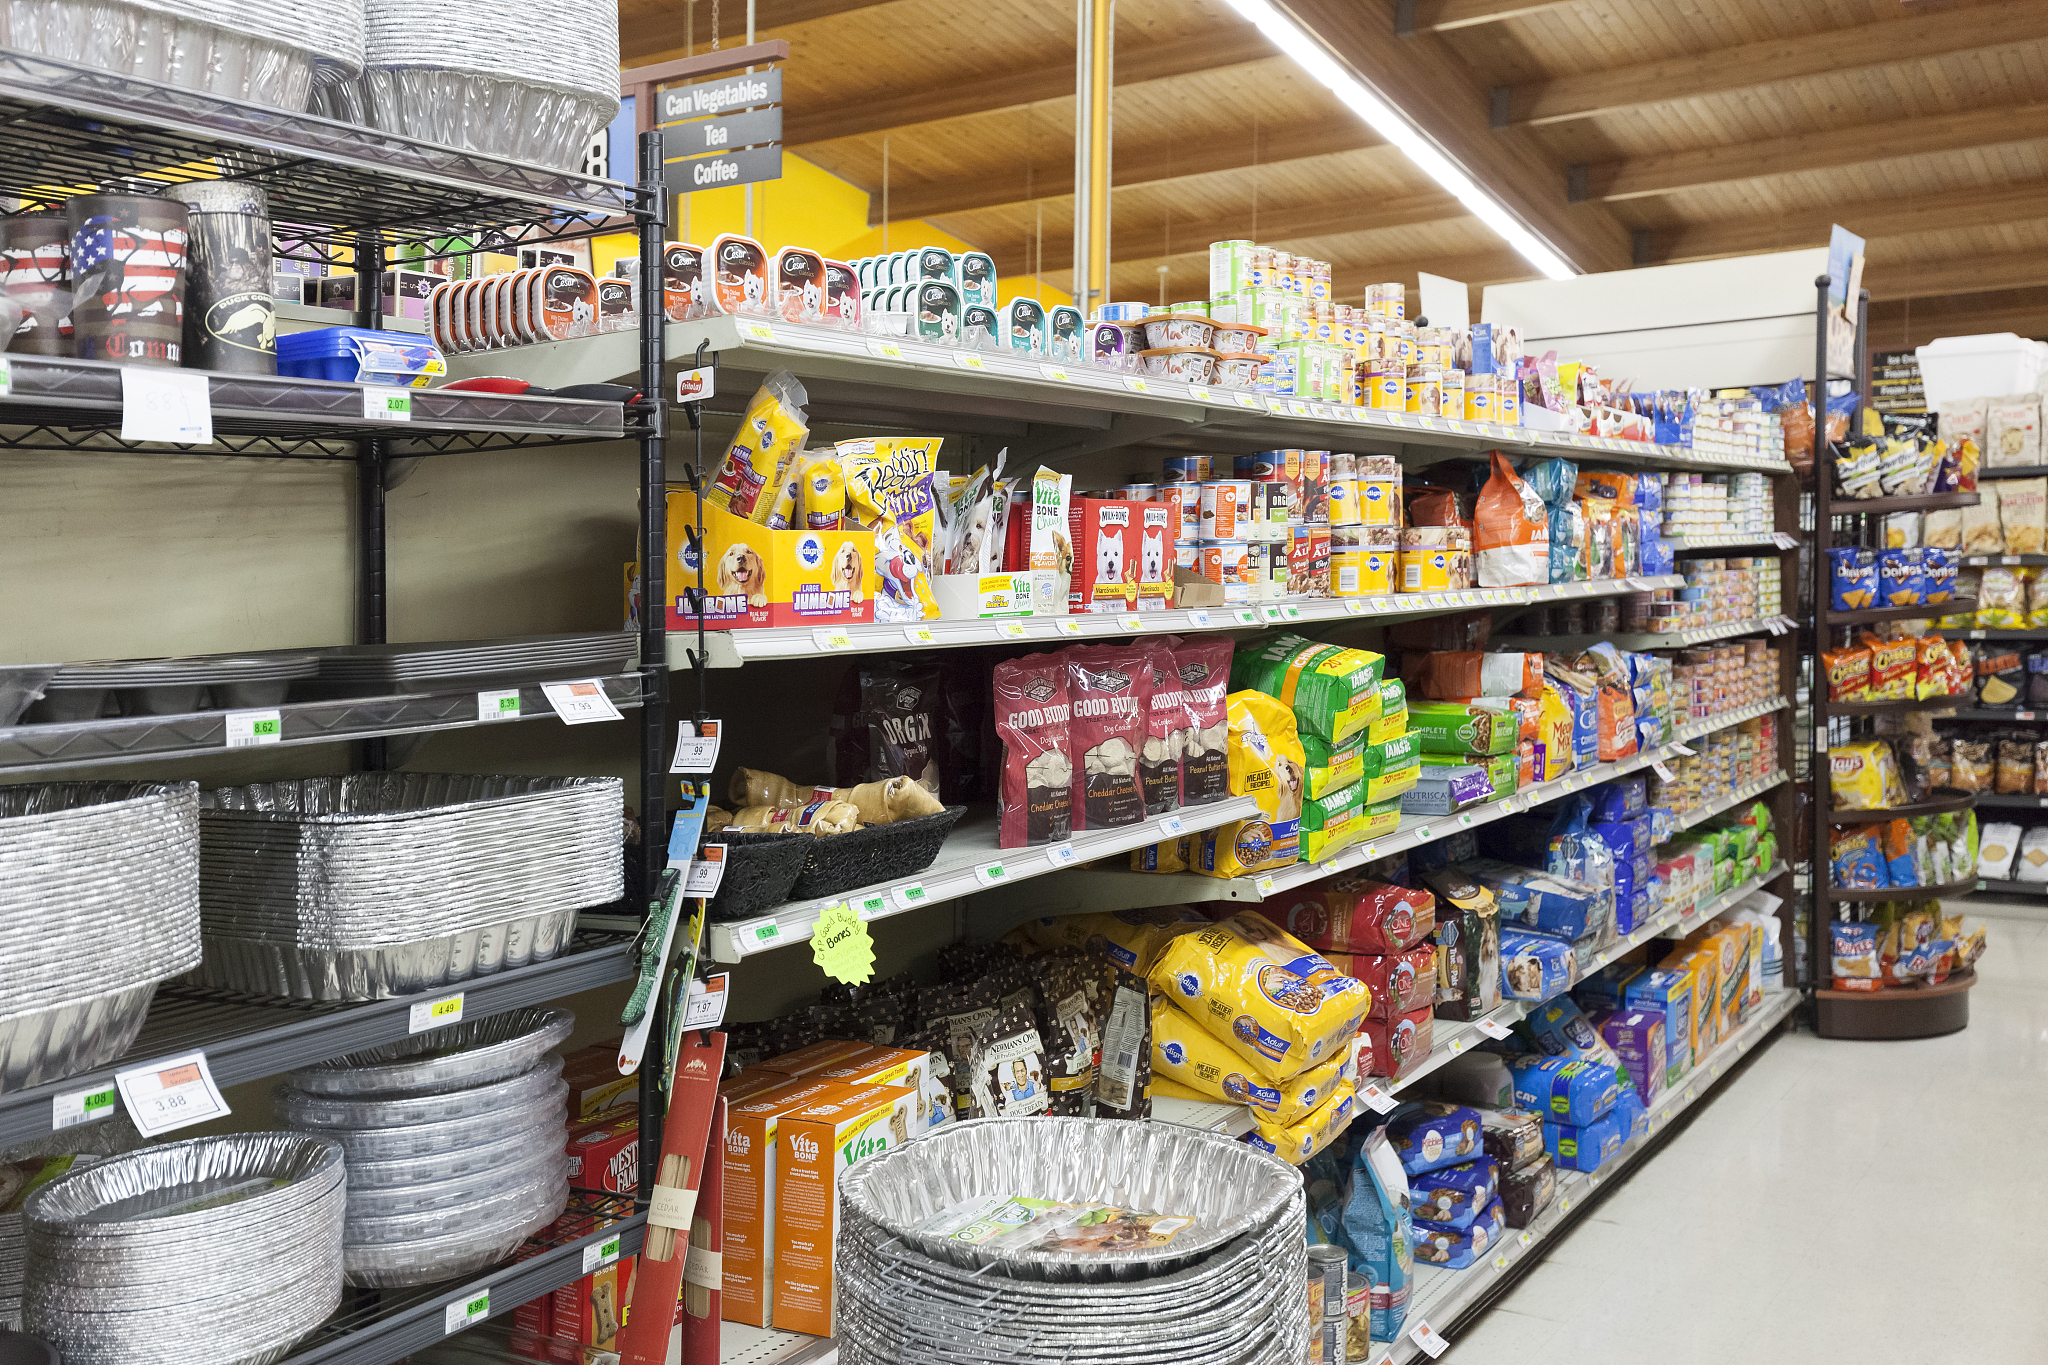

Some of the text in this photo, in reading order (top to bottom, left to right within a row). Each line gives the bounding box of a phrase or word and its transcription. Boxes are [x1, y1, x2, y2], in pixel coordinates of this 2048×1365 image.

[666, 79, 768, 117] Can Vegetables
[704, 124, 728, 147] Tea
[694, 159, 739, 186] Coffee
[724, 246, 748, 260] Cesar
[670, 254, 696, 268] Cesar
[785, 258, 808, 272] Cesar
[553, 274, 576, 288] Cesar
[601, 287, 624, 300] Cesar
[925, 289, 946, 300] Cesar
[219, 295, 250, 310] DUCK
[388, 400, 404, 409] 2.07
[1034, 480, 1061, 506] Vita
[1036, 506, 1059, 516] BONE
[1036, 514, 1062, 531] Chewy
[1881, 564, 1922, 578] Doritos
[1013, 579, 1030, 594] Vita
[794, 591, 850, 610] JUMBONE
[500, 698, 515, 710] 8.39
[570, 702, 592, 712] 7.99
[1150, 690, 1182, 710] BUDDY
[1074, 698, 1109, 718] GOOD
[1008, 708, 1043, 730] GOOD
[254, 721, 274, 735] 8.62
[1104, 725, 1115, 734] Dog
[1408, 726, 1448, 734] COMPLETE
[1553, 720, 1573, 740] Meow
[692, 746, 703, 756] .99
[1385, 740, 1405, 759] IAMS
[1557, 736, 1570, 754] Mix
[1190, 764, 1221, 774] Peanut Butter
[1146, 776, 1164, 786] Peanut
[1246, 770, 1272, 784] MEATIER
[1088, 786, 1132, 798] Cheddar Cheese
[1402, 792, 1446, 800] NUTRISCA
[1030, 800, 1068, 813] Cheddar Cheese
[696, 868, 708, 878] .99
[1503, 890, 1519, 900] Pals
[820, 912, 862, 938] Good Buddy
[1392, 918, 1411, 931] ONE
[826, 926, 852, 948] Bones
[1113, 946, 1130, 961] Adult
[1398, 978, 1414, 990] ONE
[438, 1002, 454, 1016] 4.49
[697, 1002, 712, 1014] 1.97
[1210, 998, 1232, 1015] MEATIER
[990, 1038, 1022, 1056] NEWMAN'S
[1264, 1036, 1284, 1049] Adult
[855, 1051, 904, 1070] MEDIUM
[884, 1066, 906, 1082] Great Taste!
[1196, 1062, 1220, 1076] MEATIER
[85, 1092, 106, 1107] 4.08
[776, 1084, 830, 1104] MEDIUM
[838, 1086, 888, 1106] MEDIUM
[1255, 1089, 1276, 1099] Adult
[1515, 1090, 1538, 1104] CAT
[155, 1095, 187, 1112] 3.88
[1010, 1100, 1044, 1117] DOG TREATS
[838, 1105, 892, 1145] New Look, Same Great Taste!
[728, 1144, 748, 1154] BONE
[790, 1132, 820, 1154] Vita
[1252, 1137, 1269, 1150] Adult
[794, 1151, 817, 1161] BONE
[656, 1202, 679, 1213] CEDAR
[601, 1243, 616, 1256] 2.29
[688, 1262, 708, 1273] CEDAR
[468, 1300, 484, 1314] 6.99
